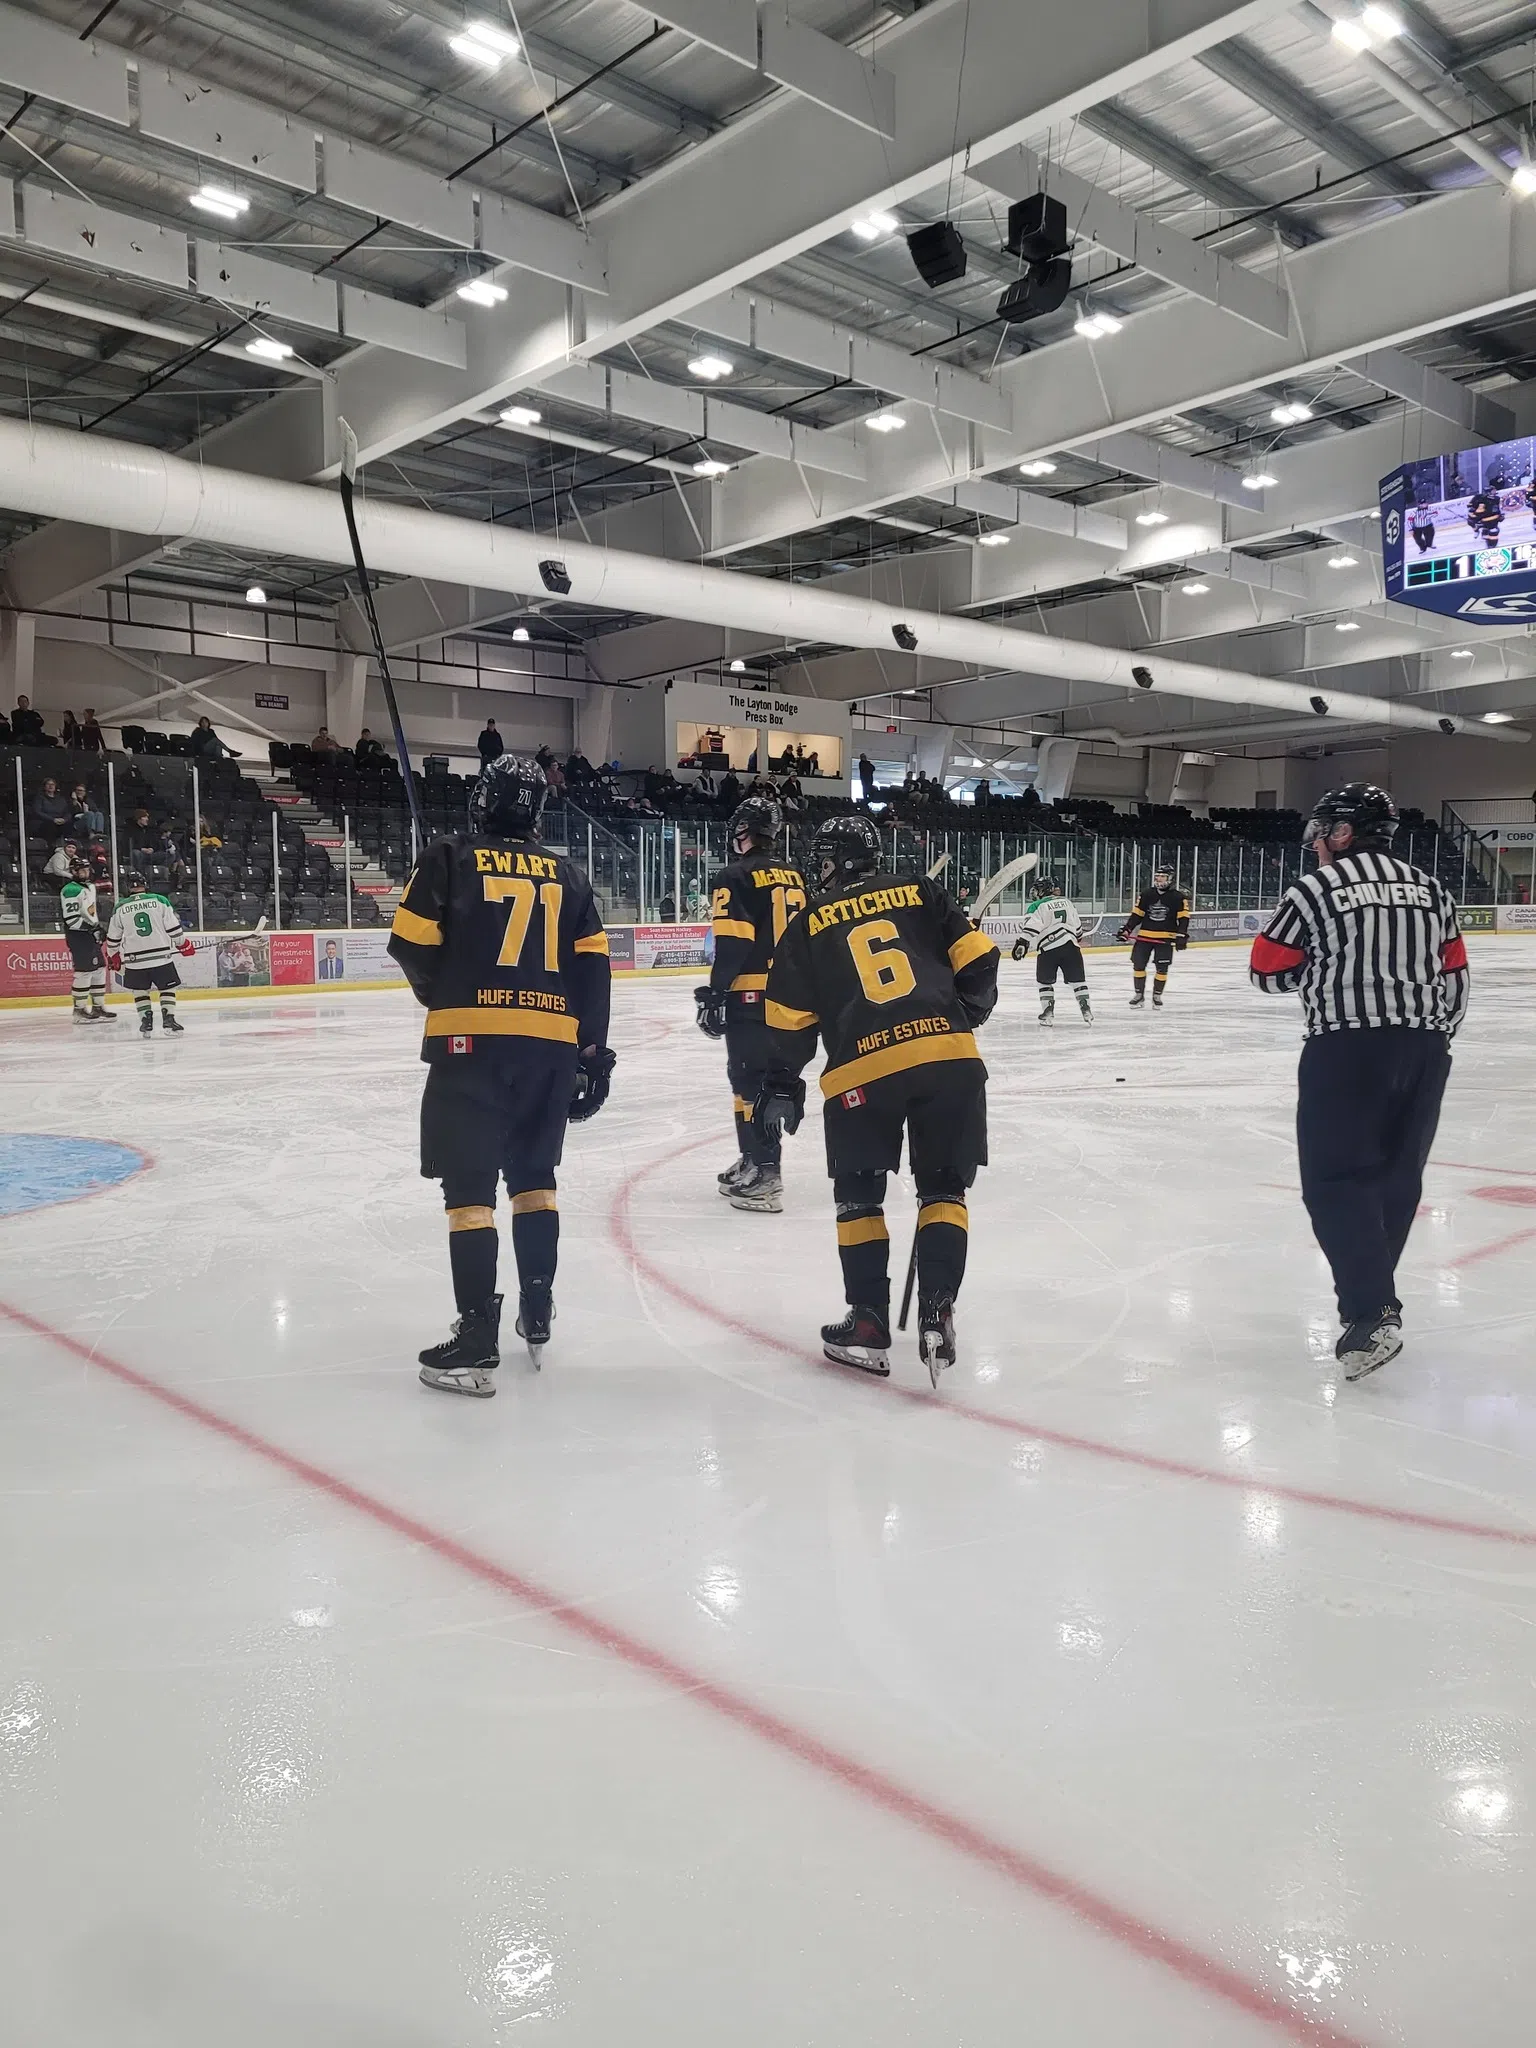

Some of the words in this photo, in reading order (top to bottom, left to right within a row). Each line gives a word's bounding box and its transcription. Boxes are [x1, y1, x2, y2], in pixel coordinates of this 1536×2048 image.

[729, 695, 745, 707] The
[747, 697, 772, 711] Layton
[774, 701, 798, 715] Dodge
[745, 711, 768, 723] Press
[769, 714, 784, 725] Box
[518, 788, 532, 806] 71
[864, 831, 873, 848] 6
[474, 849, 557, 879] EWART
[1047, 901, 1069, 911] ALBERT
[1330, 882, 1433, 913] CHILVERS
[65, 902, 80, 913] 20
[121, 901, 158, 915] LOFRANCO
[808, 885, 924, 936] ARTICHUK
[133, 911, 153, 937] 9
[483, 875, 563, 973] 71
[1054, 910, 1067, 924] 7
[272, 949, 313, 957] investments
[285, 940, 301, 948] your
[30, 961, 73, 972] RESIDEN
[846, 918, 917, 1005] 6
[477, 989, 514, 1006] HUFF
[518, 990, 567, 1012] ESTATES
[856, 1029, 890, 1054] HUFF
[893, 1017, 951, 1041] ESTATES
